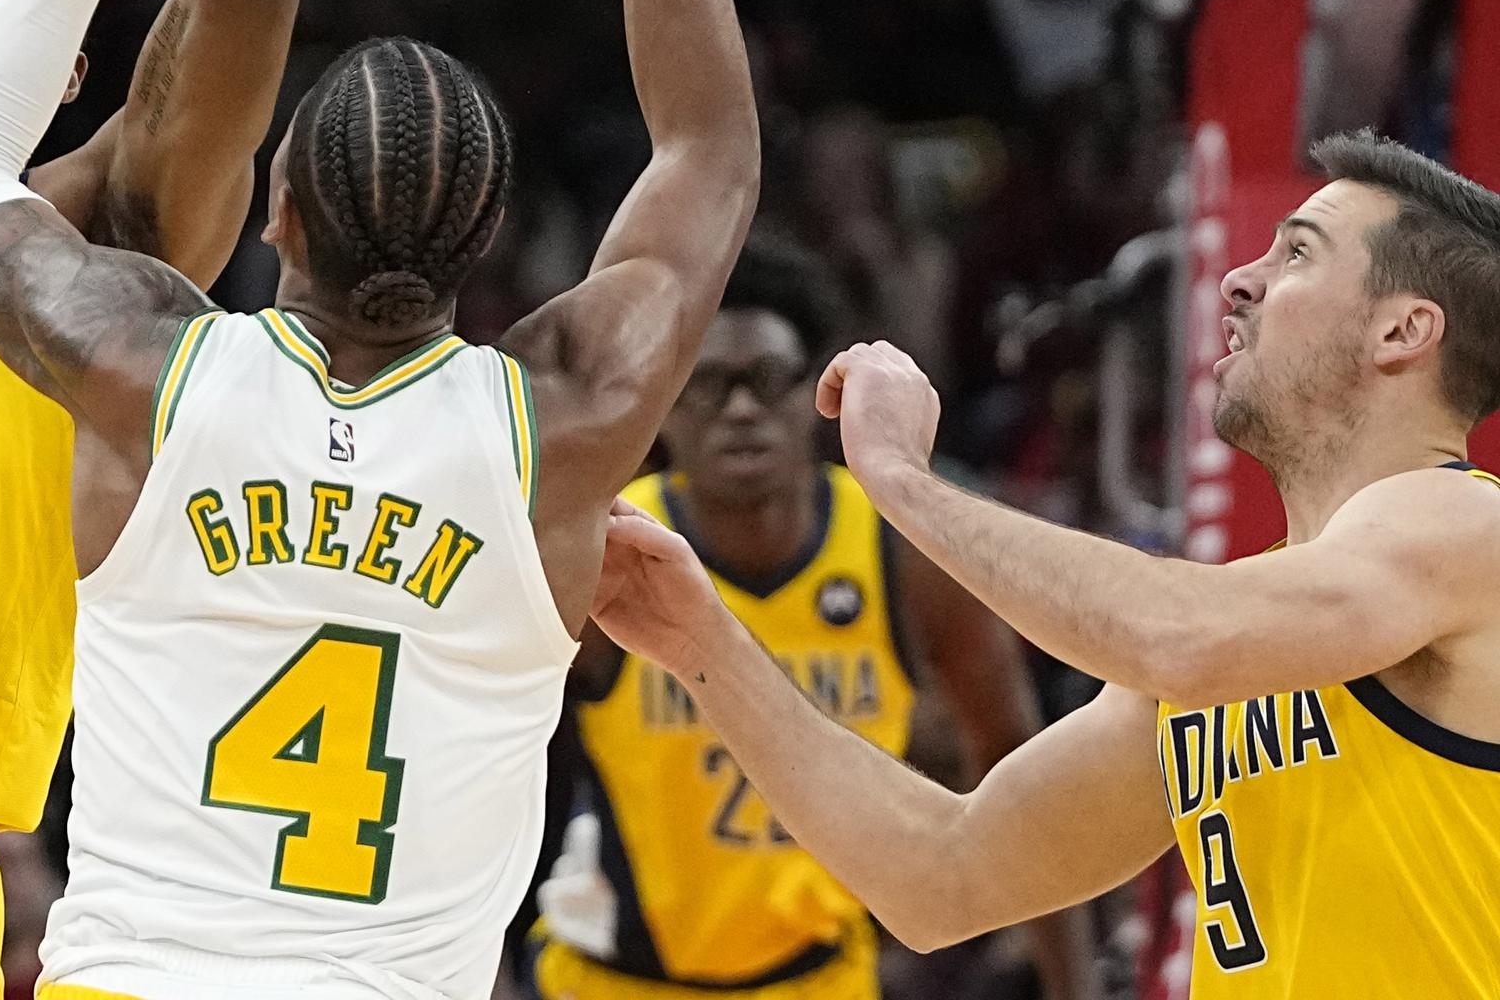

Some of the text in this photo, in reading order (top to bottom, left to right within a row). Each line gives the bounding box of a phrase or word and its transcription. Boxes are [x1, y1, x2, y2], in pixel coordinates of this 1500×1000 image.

[185, 479, 484, 609] GREEN
[200, 622, 406, 906] 4
[702, 745, 797, 845] 2
[1197, 808, 1268, 973] 9
